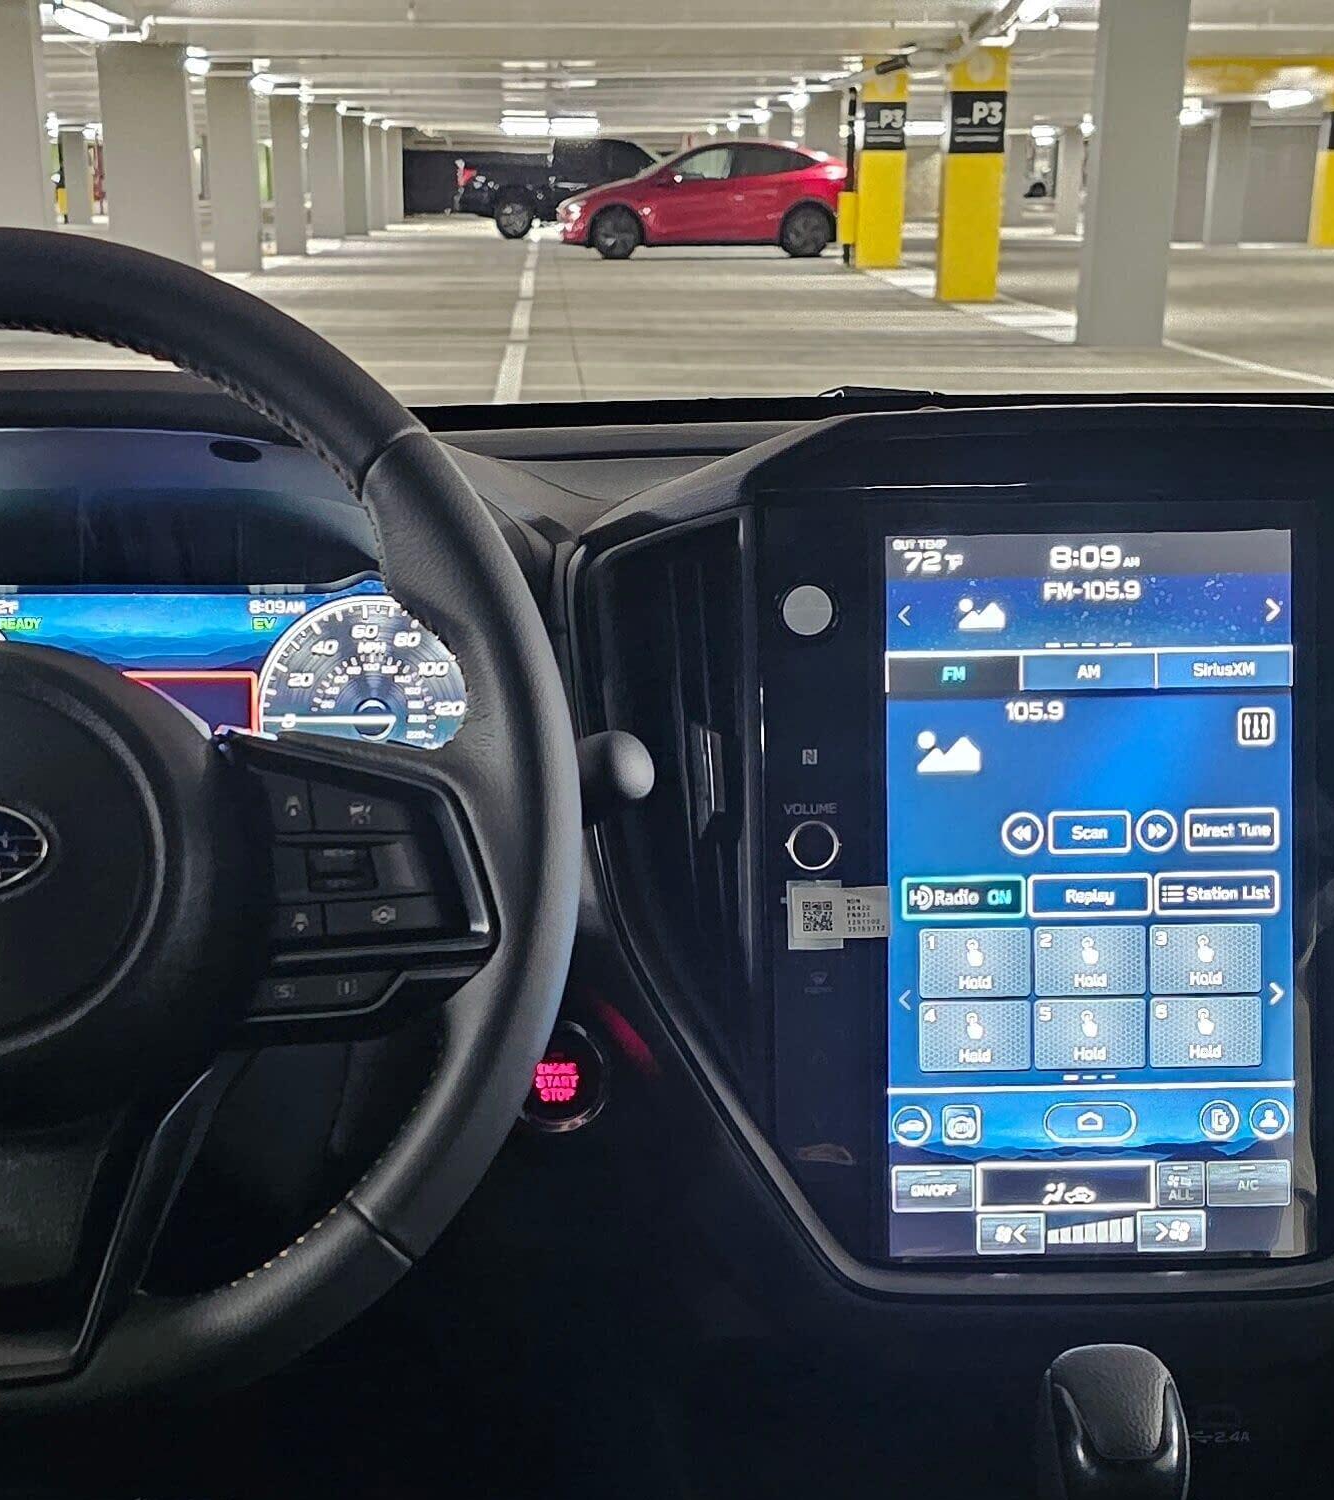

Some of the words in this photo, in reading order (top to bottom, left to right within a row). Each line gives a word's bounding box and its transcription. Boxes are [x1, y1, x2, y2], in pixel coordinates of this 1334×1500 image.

[1050, 545, 1122, 571] 8:09
[1043, 580, 1141, 601] FM-105.9
[253, 617, 276, 631] EV
[351, 624, 378, 640] 60
[394, 632, 422, 647] 80
[311, 639, 339, 656] 40
[357, 641, 386, 655] MPH
[419, 662, 449, 678] 100
[942, 666, 966, 681] FM
[1077, 665, 1101, 680] AM
[1193, 662, 1256, 677] SiriusXM
[288, 672, 314, 688] 20
[434, 701, 466, 716] 120
[1005, 701, 1064, 721] 105.9
[783, 803, 838, 815] VOLUME
[1071, 825, 1108, 841] Scan
[1193, 824, 1235, 839] Direct
[1238, 823, 1272, 838] Tune
[934, 890, 979, 905] Radio
[987, 890, 1013, 905] ON
[1065, 888, 1115, 906] Replay
[1186, 885, 1238, 901] Station
[1242, 885, 1271, 900] List
[926, 936, 936, 950] 1
[1040, 934, 1052, 948] 2
[1155, 932, 1168, 946] 3
[959, 975, 992, 990] Hold
[1074, 973, 1107, 988] Hold
[1189, 971, 1223, 986] Hold
[924, 1009, 937, 1023] 4
[1039, 1007, 1052, 1021] 5
[1155, 1005, 1168, 1019] 6
[959, 1048, 992, 1063] Hold
[1074, 1046, 1107, 1061] Hold
[1189, 1044, 1223, 1059] Hold
[535, 1075, 579, 1089] START
[540, 1089, 576, 1102] STOP
[910, 1183, 957, 1198] ON/OFF
[1237, 1179, 1260, 1191] A/C
[1168, 1189, 1194, 1202] ALL
